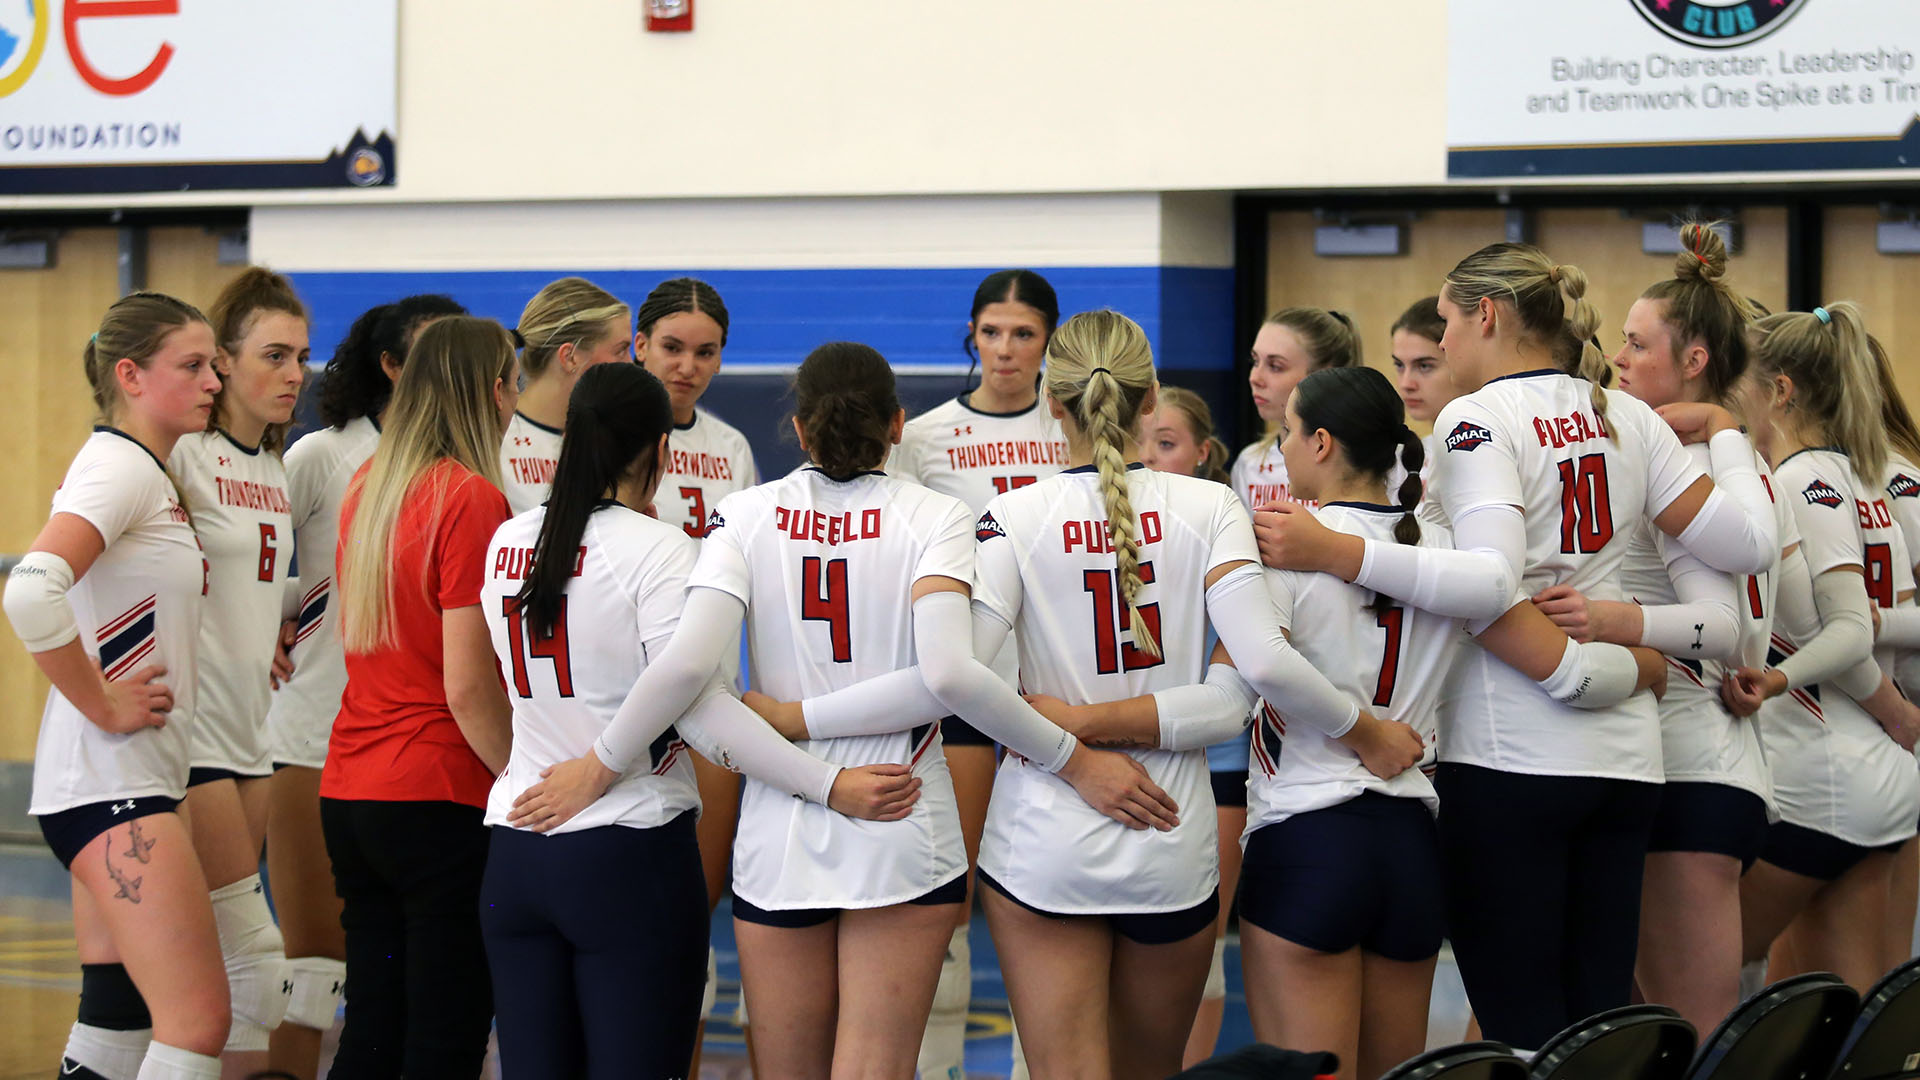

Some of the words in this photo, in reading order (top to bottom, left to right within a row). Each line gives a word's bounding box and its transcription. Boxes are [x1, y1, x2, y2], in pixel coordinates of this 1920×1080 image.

[1682, 3, 1757, 37] CLUB
[1551, 57, 1641, 85] Building
[1645, 53, 1773, 79] Character,
[1779, 48, 1914, 76] Leadership
[1526, 90, 1570, 113] and
[1576, 87, 1697, 112] Teamwork
[1703, 84, 1749, 108] One
[1757, 81, 1821, 111] Spike
[1827, 86, 1851, 105] at
[1859, 87, 1874, 104] a
[0, 122, 182, 150] OUNDATION
[1447, 429, 1491, 450] RMAC
[679, 486, 706, 538] 3
[776, 506, 881, 547] PUEBLO
[1557, 453, 1614, 554] 10
[258, 522, 277, 583] 6
[1864, 542, 1894, 608] 9
[802, 556, 852, 663] 4
[1083, 561, 1165, 675] 15
[502, 594, 575, 698] 14
